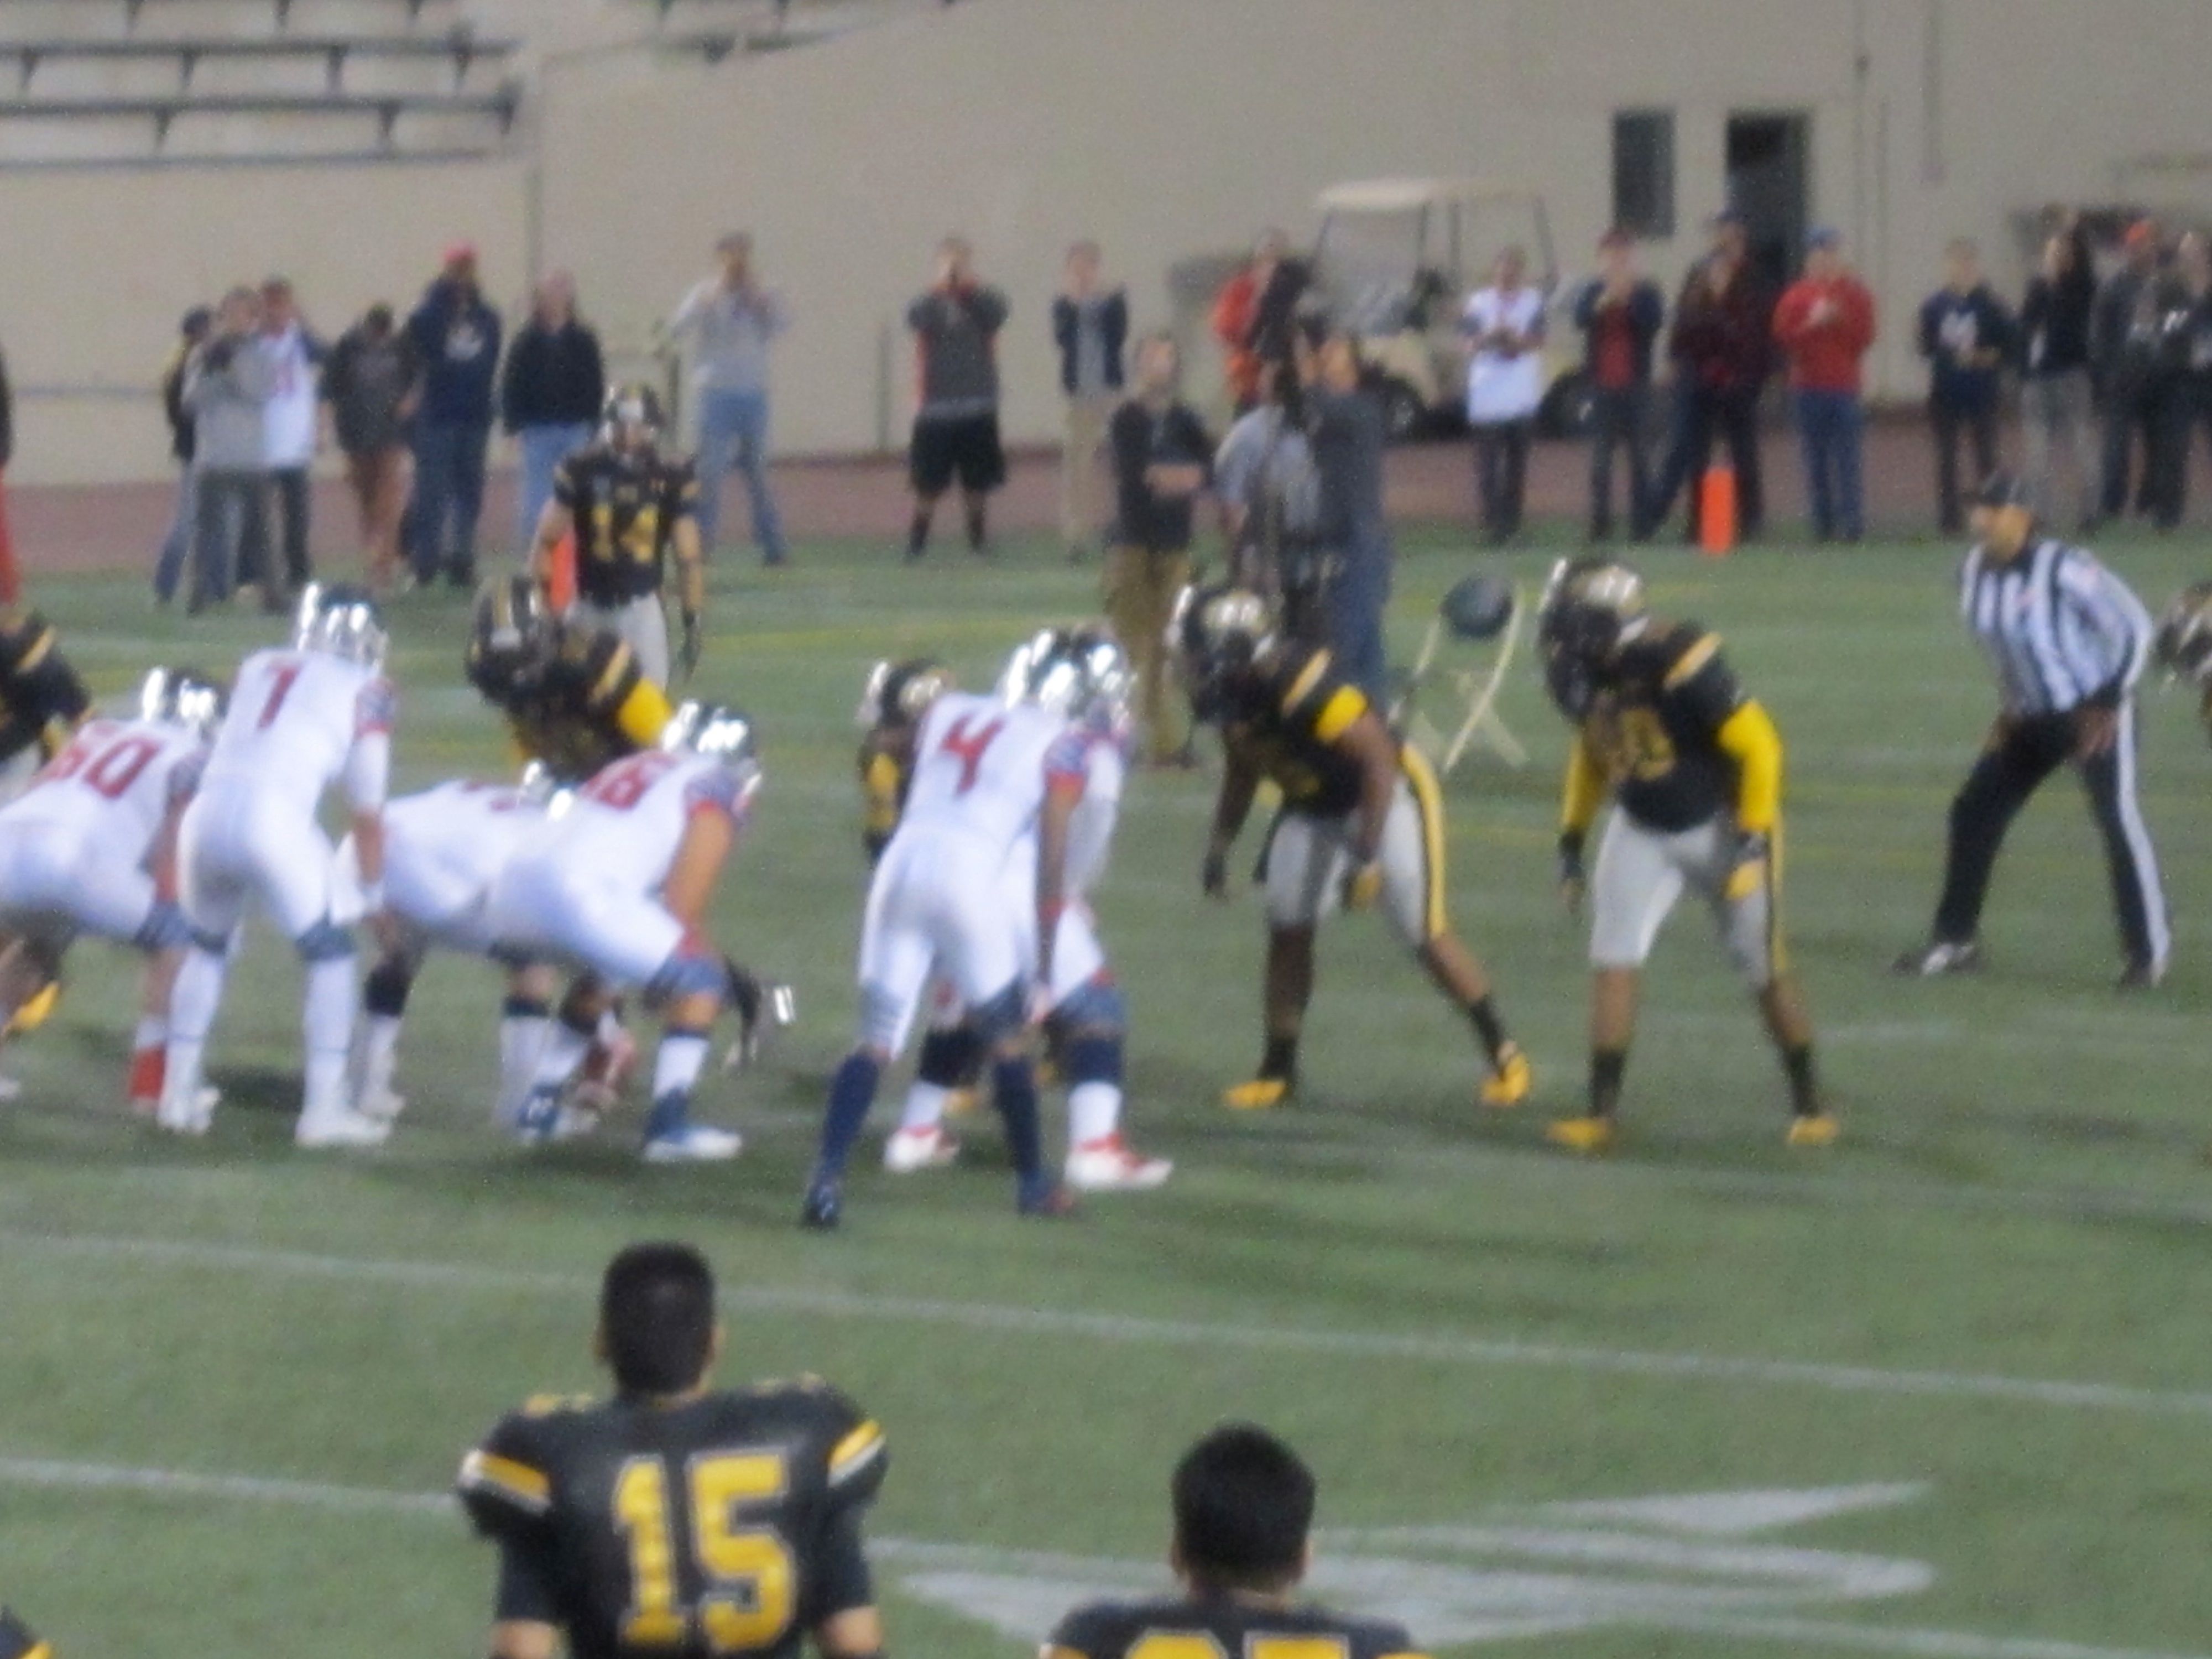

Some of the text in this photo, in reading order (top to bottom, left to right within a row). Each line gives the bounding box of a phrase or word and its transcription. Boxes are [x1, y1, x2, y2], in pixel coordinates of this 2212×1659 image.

[589, 501, 658, 564] 14
[941, 716, 1004, 796] 4
[612, 1443, 799, 1651] 15
